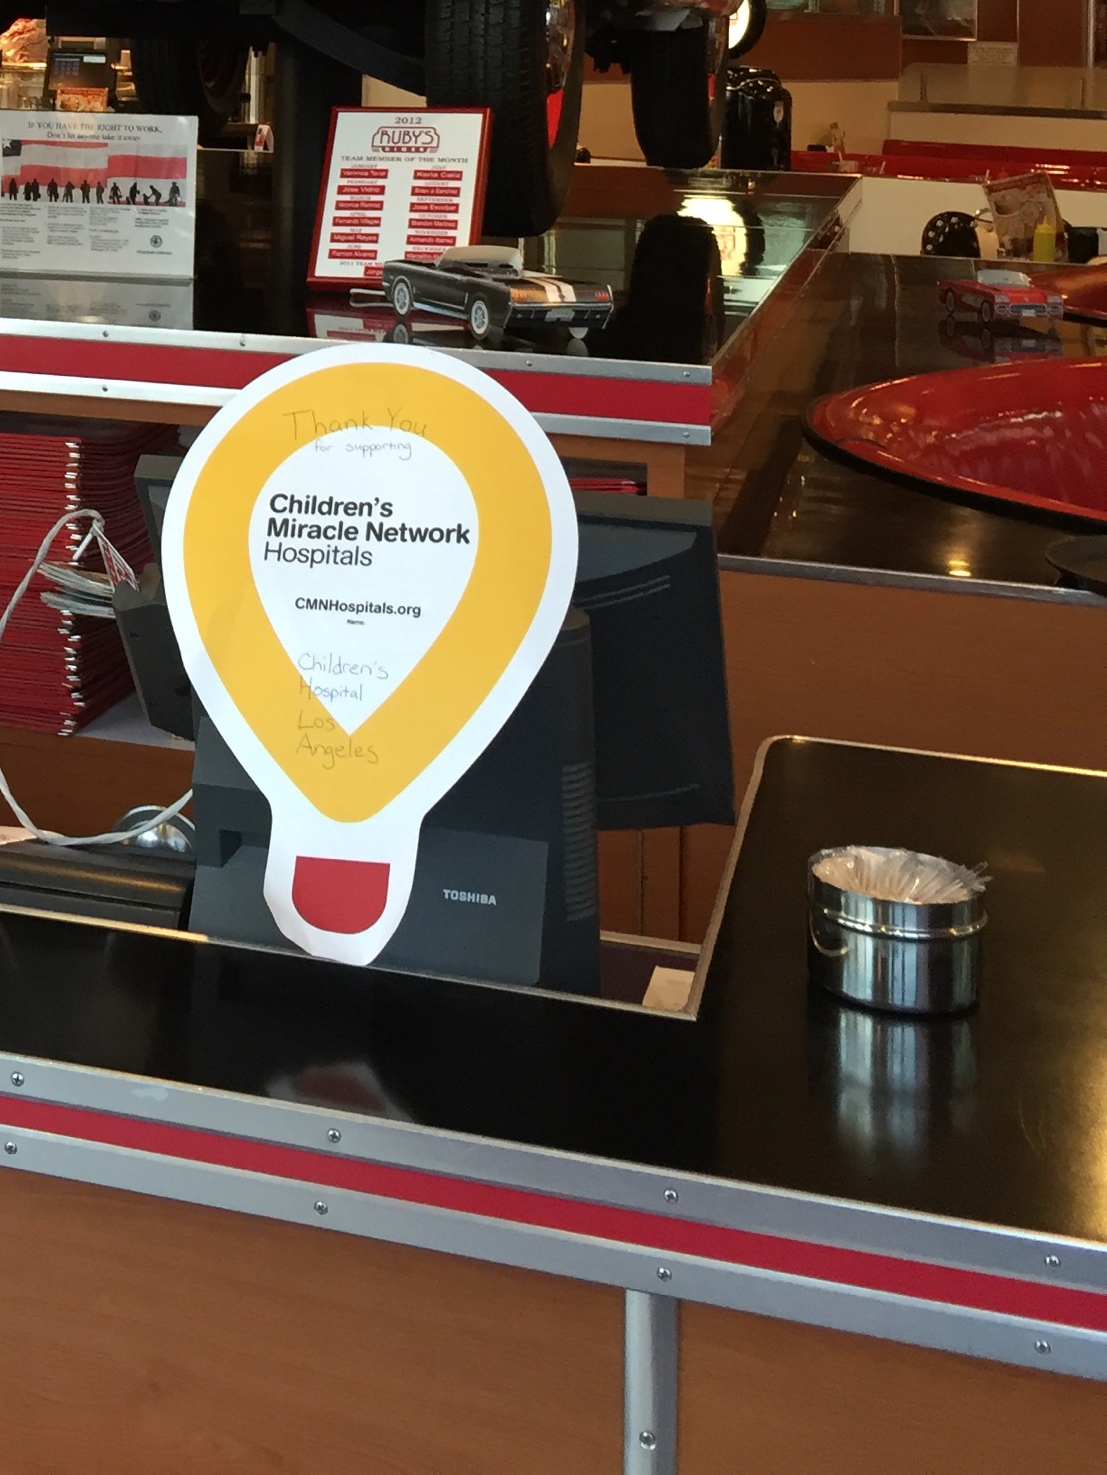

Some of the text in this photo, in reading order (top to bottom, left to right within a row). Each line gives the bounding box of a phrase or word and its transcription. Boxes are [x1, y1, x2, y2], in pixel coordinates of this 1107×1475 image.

[97, 124, 122, 132] RIGHT
[395, 116, 423, 125] 2012
[379, 129, 435, 145] RUBY'S
[283, 406, 427, 440] Thank You
[314, 438, 412, 461] for supporting
[269, 492, 394, 518] Children's
[266, 517, 471, 545] Miracle Network
[264, 540, 374, 569] Hospitals
[294, 596, 422, 619] CMNHospitals.org
[297, 652, 389, 680] Children's
[299, 675, 363, 703] Hospital
[297, 708, 335, 731] Los
[295, 732, 379, 770] Angeles
[442, 888, 497, 906] TOSHIBA
